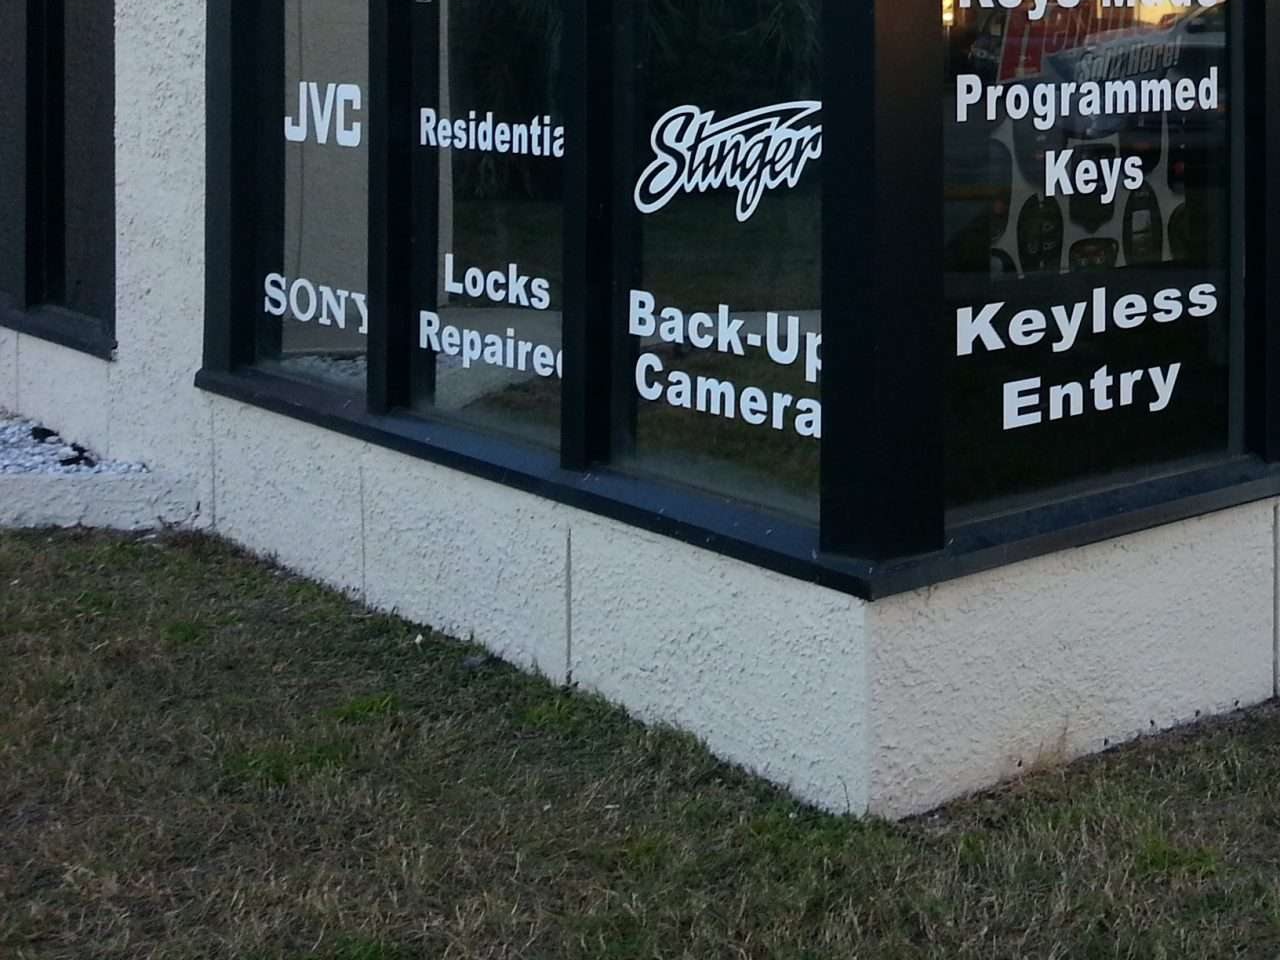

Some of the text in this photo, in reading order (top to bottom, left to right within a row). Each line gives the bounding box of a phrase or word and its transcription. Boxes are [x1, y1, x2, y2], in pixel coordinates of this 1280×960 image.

[284, 81, 362, 147] JVC
[956, 66, 1219, 130] Programmed
[420, 107, 565, 158] Residentia
[1045, 149, 1144, 204] Keys
[444, 253, 551, 310] Locks
[420, 310, 564, 380] Repaire
[629, 289, 823, 385] Back-Up
[956, 282, 1218, 357] Keyless
[635, 352, 823, 439] Camera
[1003, 362, 1181, 430] Entry
